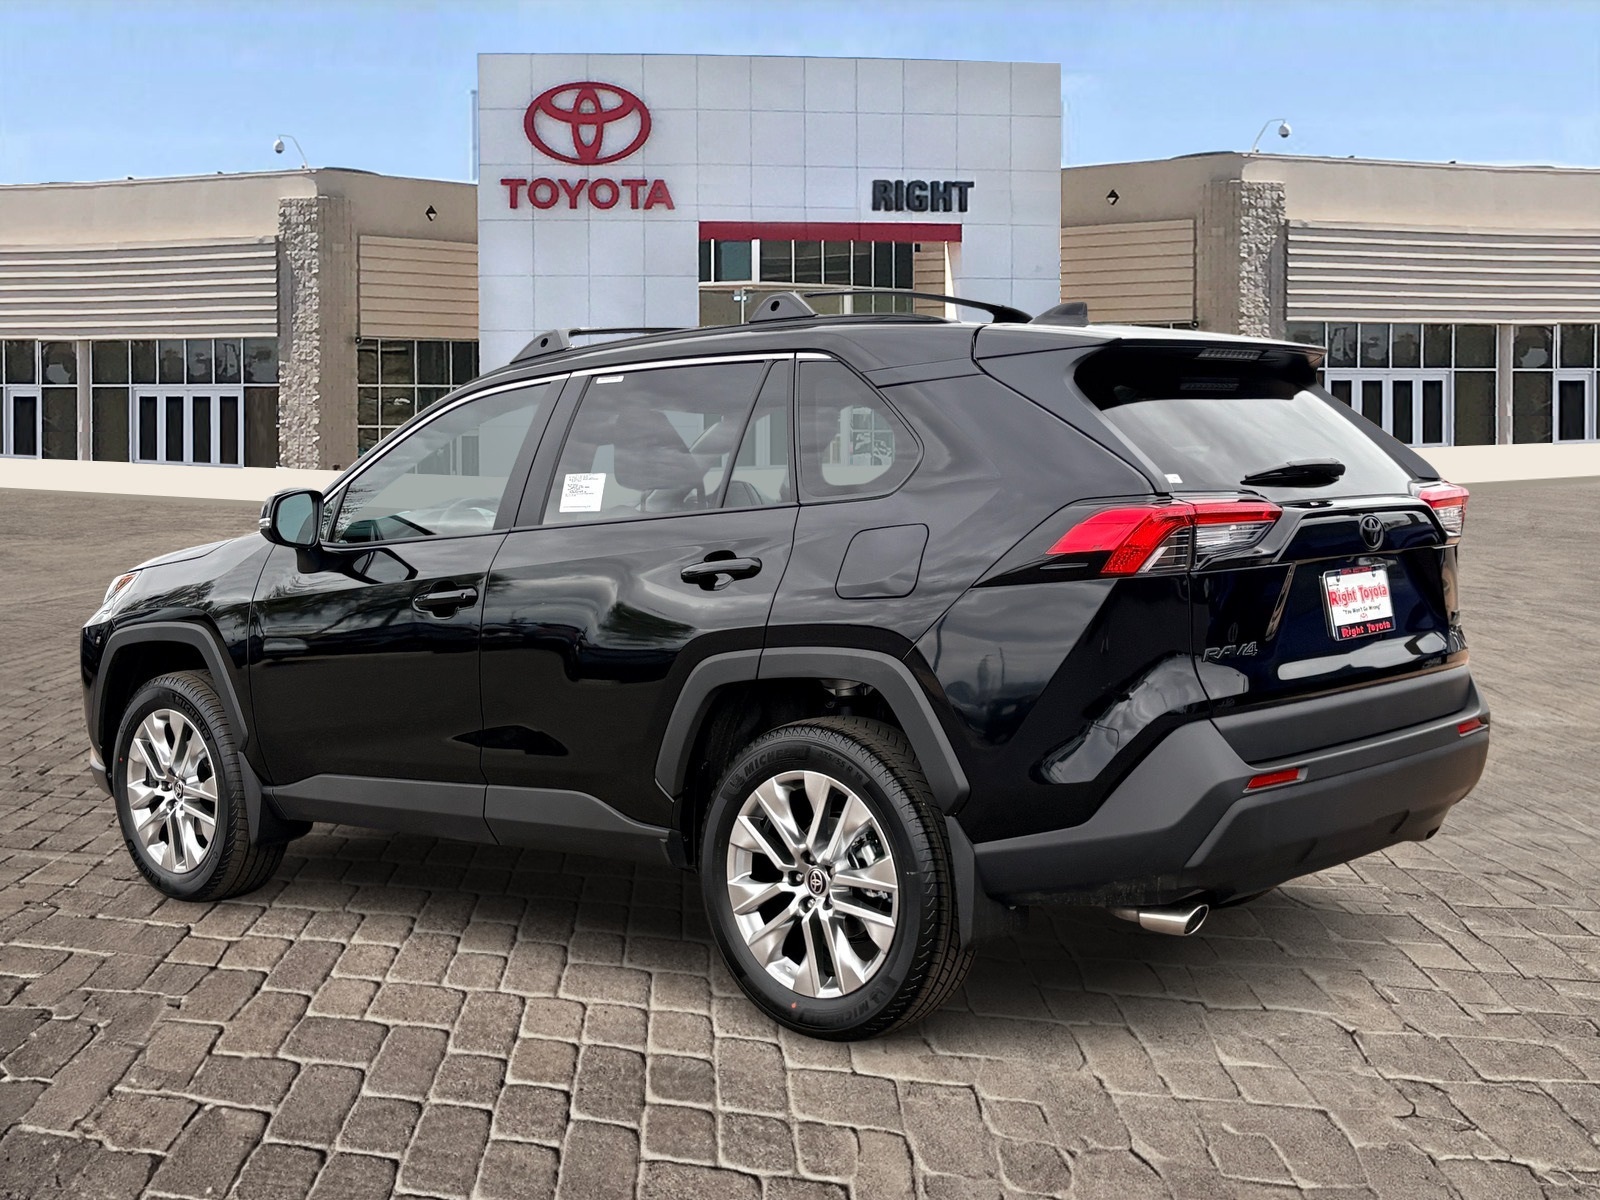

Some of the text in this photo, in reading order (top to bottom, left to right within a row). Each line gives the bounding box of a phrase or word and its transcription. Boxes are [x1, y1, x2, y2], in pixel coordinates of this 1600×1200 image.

[500, 178, 675, 210] TOYOTA
[872, 179, 974, 212] RIGHT
[1329, 585, 1388, 607] Right Toyota
[1341, 621, 1391, 638] Right Toyota
